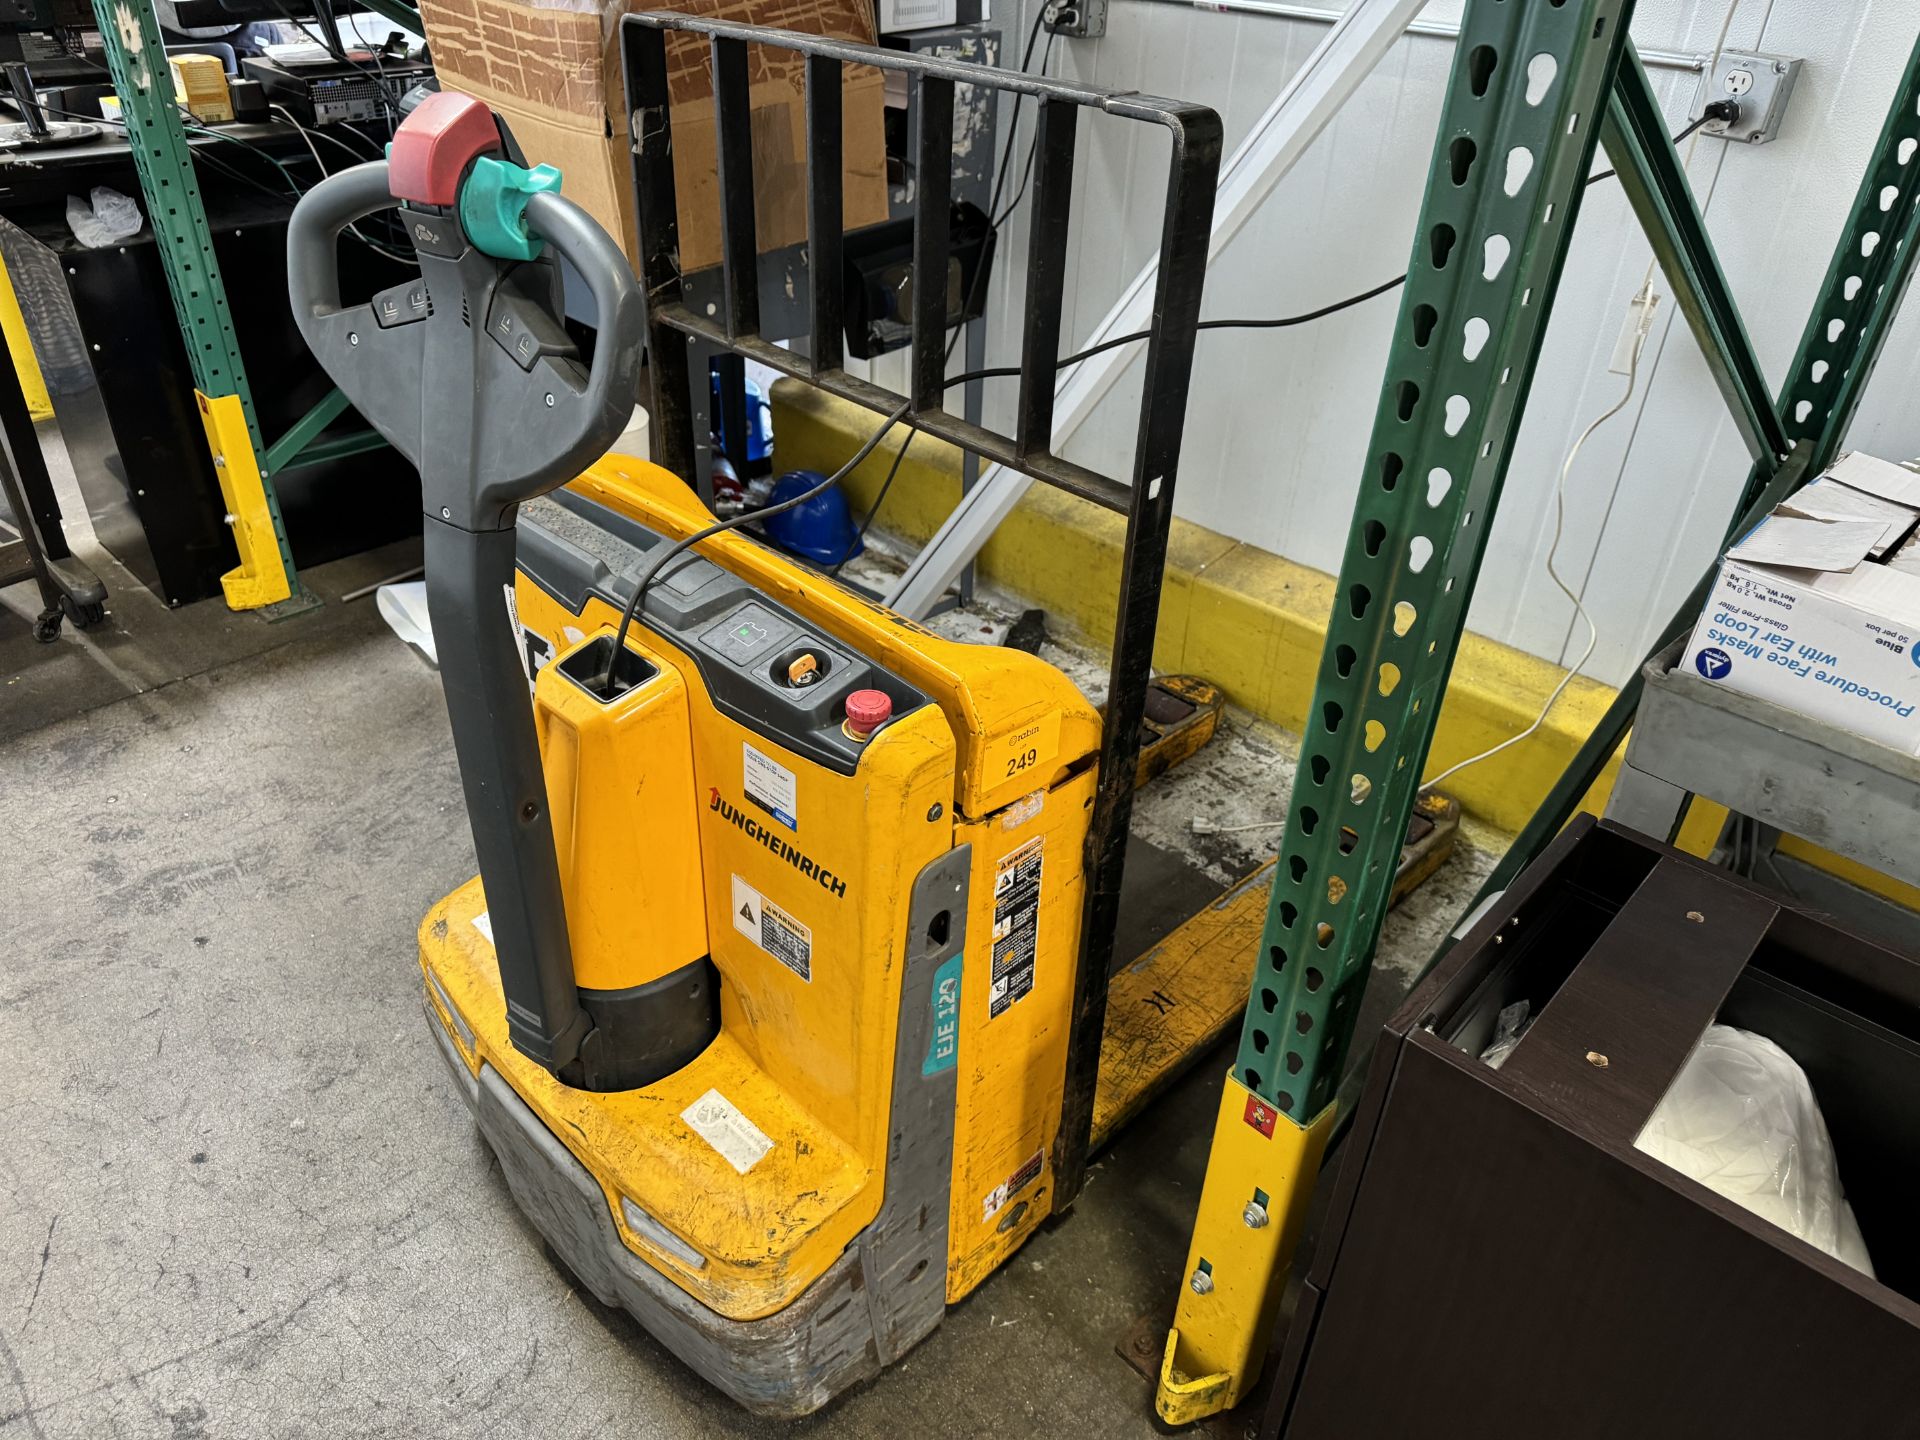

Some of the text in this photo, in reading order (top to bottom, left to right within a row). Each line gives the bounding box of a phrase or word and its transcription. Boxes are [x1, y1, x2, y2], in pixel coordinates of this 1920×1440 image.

[1726, 581, 1737, 590] kg
[1729, 573, 1740, 583] kg
[1769, 597, 1793, 610] Gross
[1780, 592, 1796, 603] Net
[1717, 600, 1789, 631] Glass-Free Filter
[1713, 612, 1838, 668] with Ear Loop
[1865, 622, 1909, 643] 50 per box
[1875, 637, 1904, 654] Blue
[1707, 628, 1916, 718] Procedure Face Masks
[1018, 726, 1040, 742] rabin
[1006, 749, 1037, 777] 249
[710, 796, 847, 898] JUNGHEINRICH
[771, 910, 805, 937] WARNING
[936, 977, 957, 1059] EJE 120
